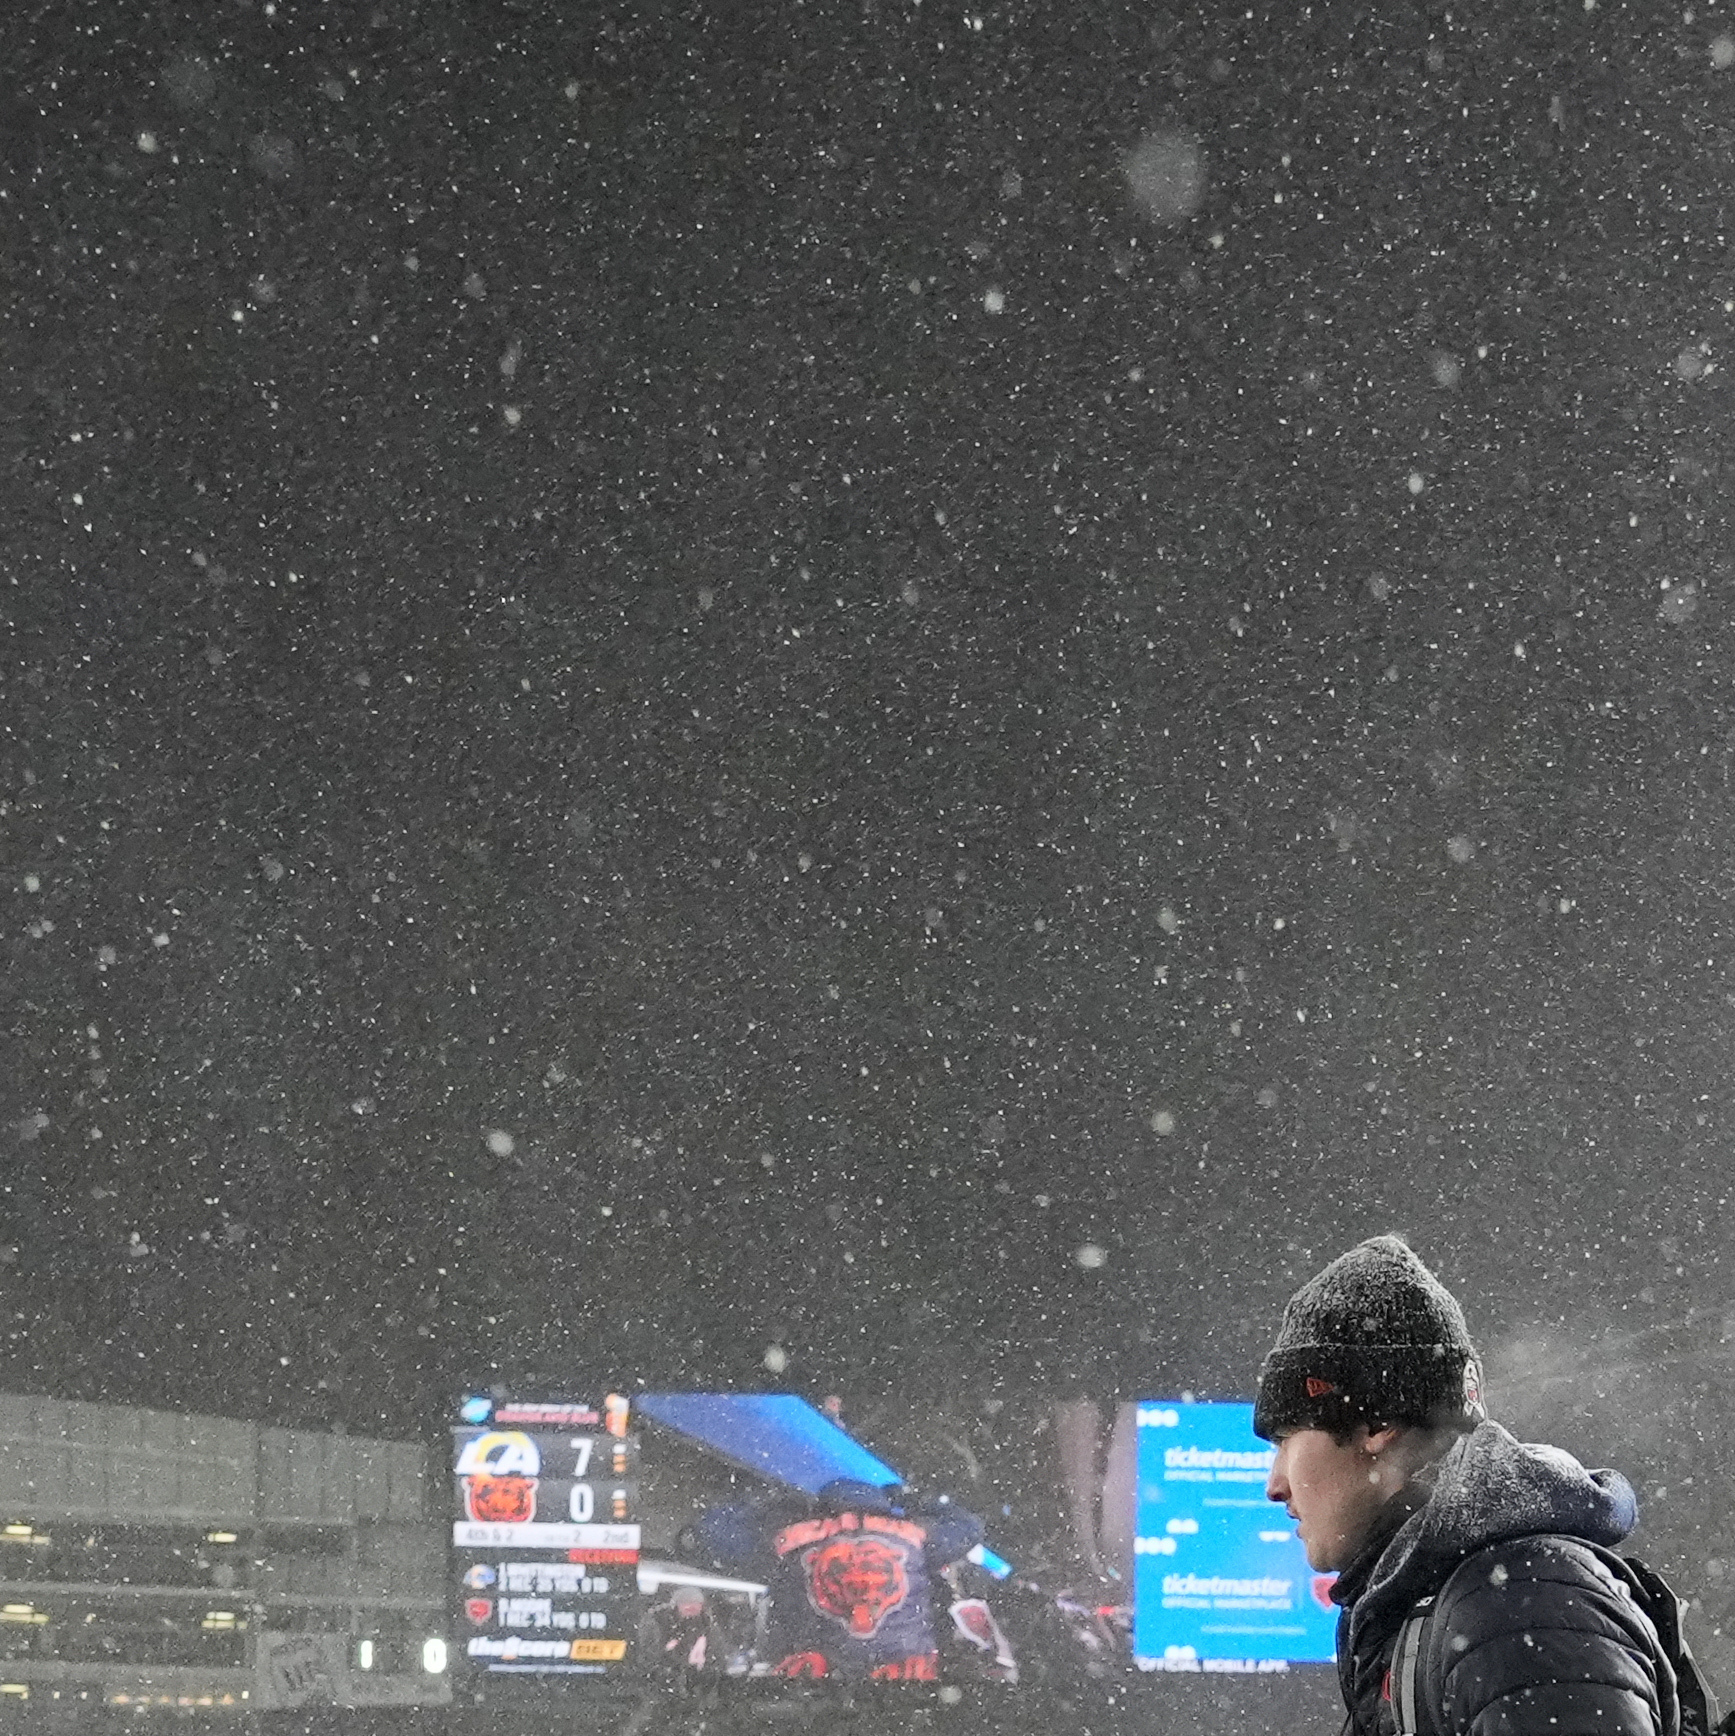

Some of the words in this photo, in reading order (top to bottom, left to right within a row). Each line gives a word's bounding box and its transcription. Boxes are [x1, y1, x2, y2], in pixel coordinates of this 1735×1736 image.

[570, 1438, 594, 1476] 7
[1165, 1446, 1276, 1469] ticketmast
[570, 1483, 594, 1522] 0
